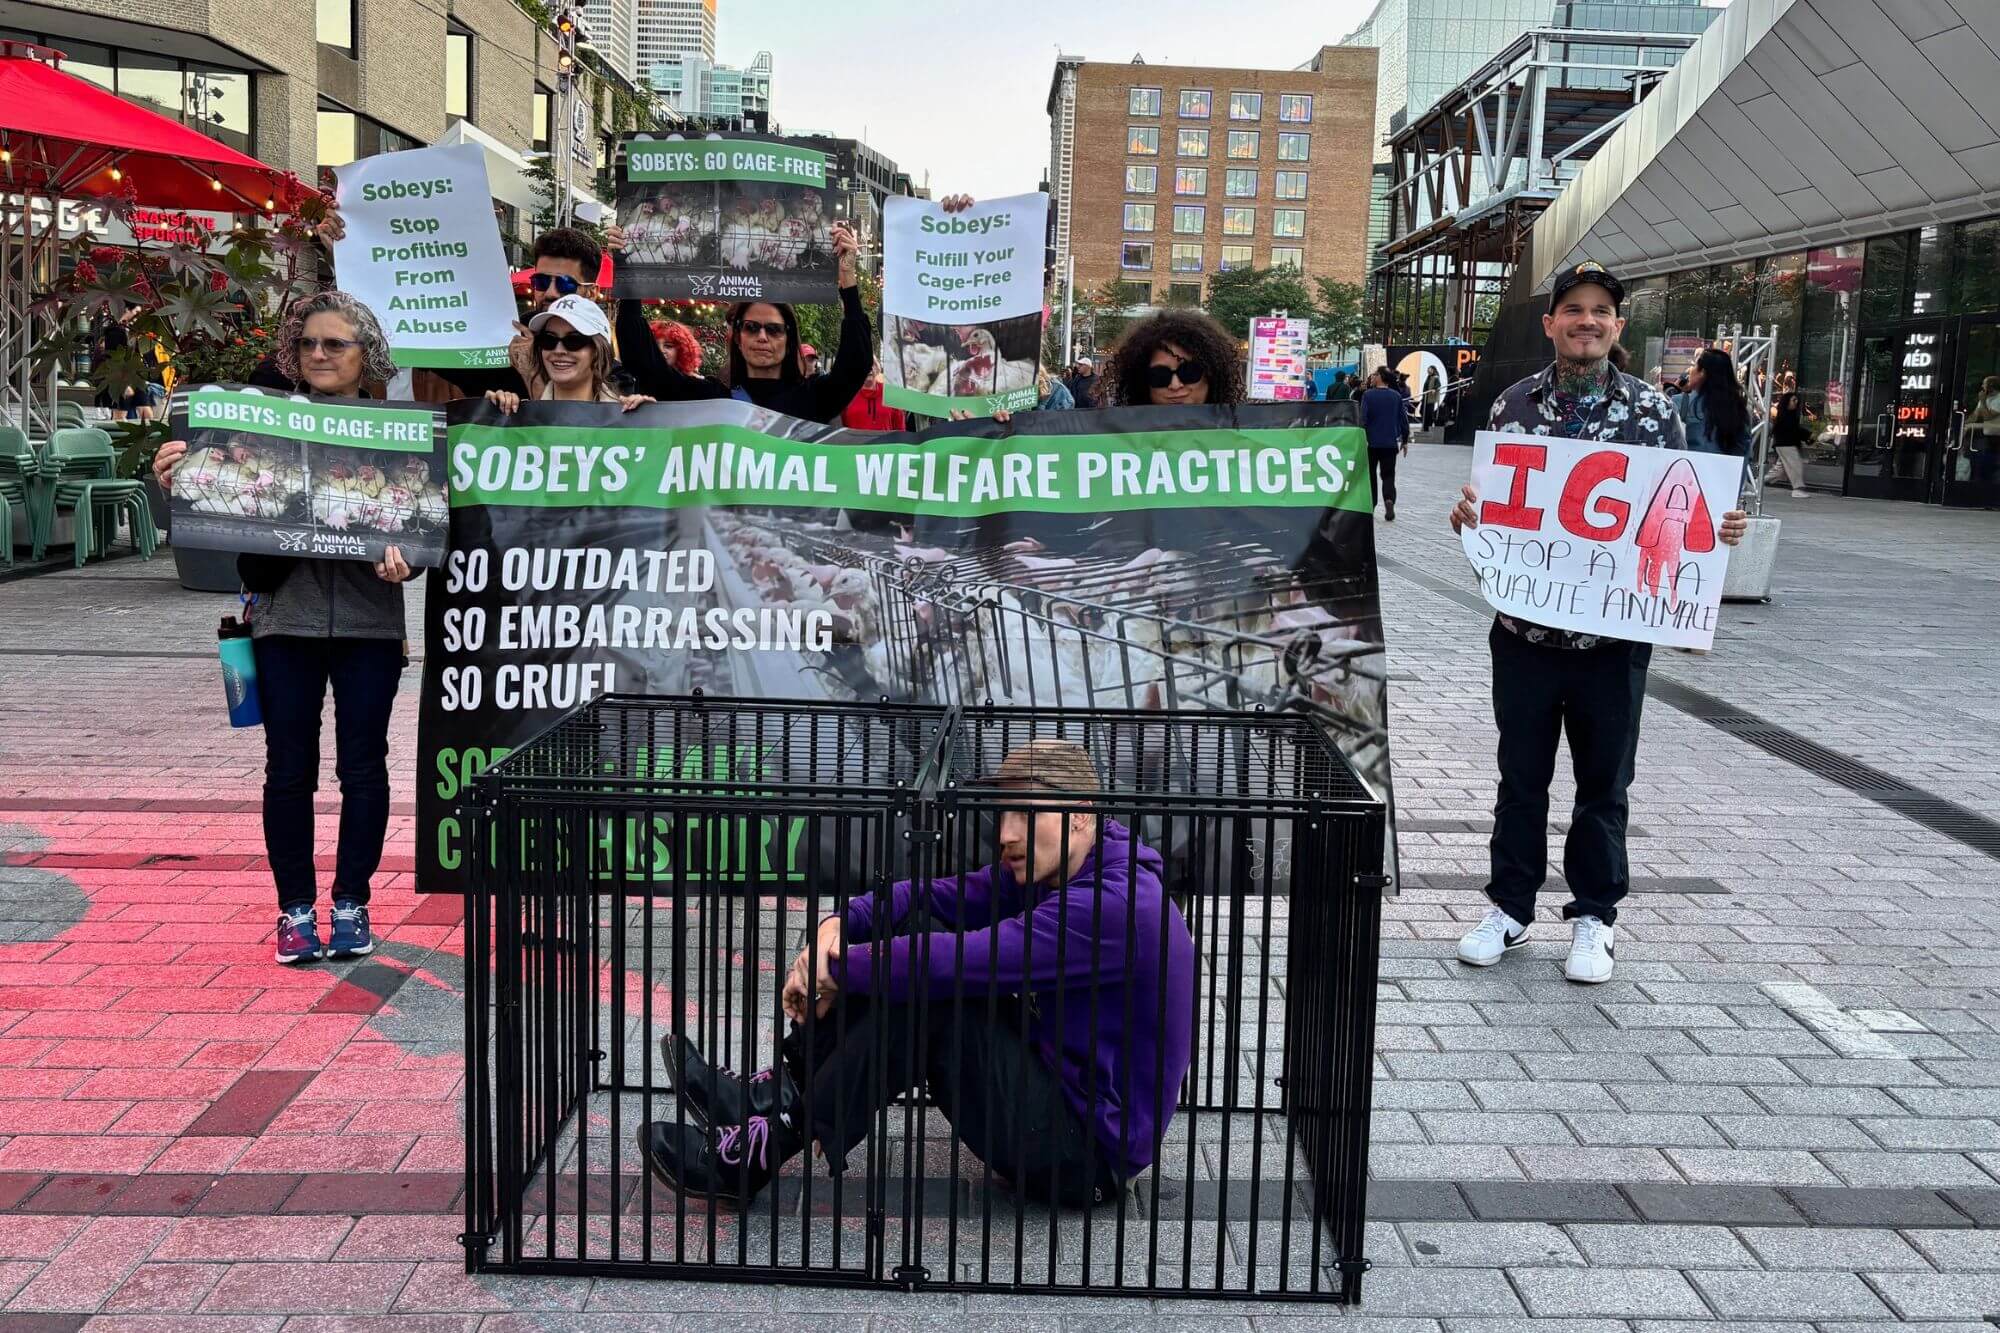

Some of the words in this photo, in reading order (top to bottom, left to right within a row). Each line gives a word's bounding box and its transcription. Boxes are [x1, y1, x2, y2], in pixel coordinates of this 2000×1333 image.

[631, 152, 699, 172] SOBEYS:
[704, 151, 727, 171] GO
[732, 152, 822, 179] CAGE-FREE
[362, 177, 453, 201] Sobeys:
[0, 193, 109, 235] AGE
[920, 213, 1011, 235] Sobeys:
[390, 217, 440, 235] Stop
[371, 241, 468, 262] Profiting
[916, 249, 968, 267] Fulfill
[974, 246, 1015, 265] Your
[395, 268, 455, 286] From
[718, 275, 763, 287] ANIMAL
[917, 270, 1012, 291] Cage-Free
[388, 291, 469, 311] Animal
[717, 286, 763, 297] JUSTICE
[927, 294, 1002, 311] Promise
[395, 318, 467, 334] Abuse
[485, 348, 509, 357] ANIM
[1006, 397, 1036, 410] JUSTICE
[1007, 387, 1037, 401] ANIMAL
[194, 401, 282, 426] SOBEYS:
[288, 411, 316, 433] GO
[323, 415, 429, 442] CAGE-FREE
[452, 442, 645, 493] SOBEYS’
[657, 441, 838, 495] ANIMAL
[855, 452, 1061, 503] WELFARE
[1077, 444, 1356, 499] PRACTICES:
[1480, 443, 1716, 553] IGA
[311, 544, 366, 555] JUSTICE
[312, 533, 365, 546] ANIMAL
[447, 549, 489, 594] SO
[501, 547, 715, 593] OUTDATED
[1477, 529, 1572, 571] STOP
[1584, 544, 1618, 581] À
[1643, 560, 1707, 595] LA
[1602, 583, 1719, 632] ANIMALE
[443, 606, 486, 654] SO
[498, 604, 834, 653] EMBARRASSING
[441, 666, 481, 711] SO
